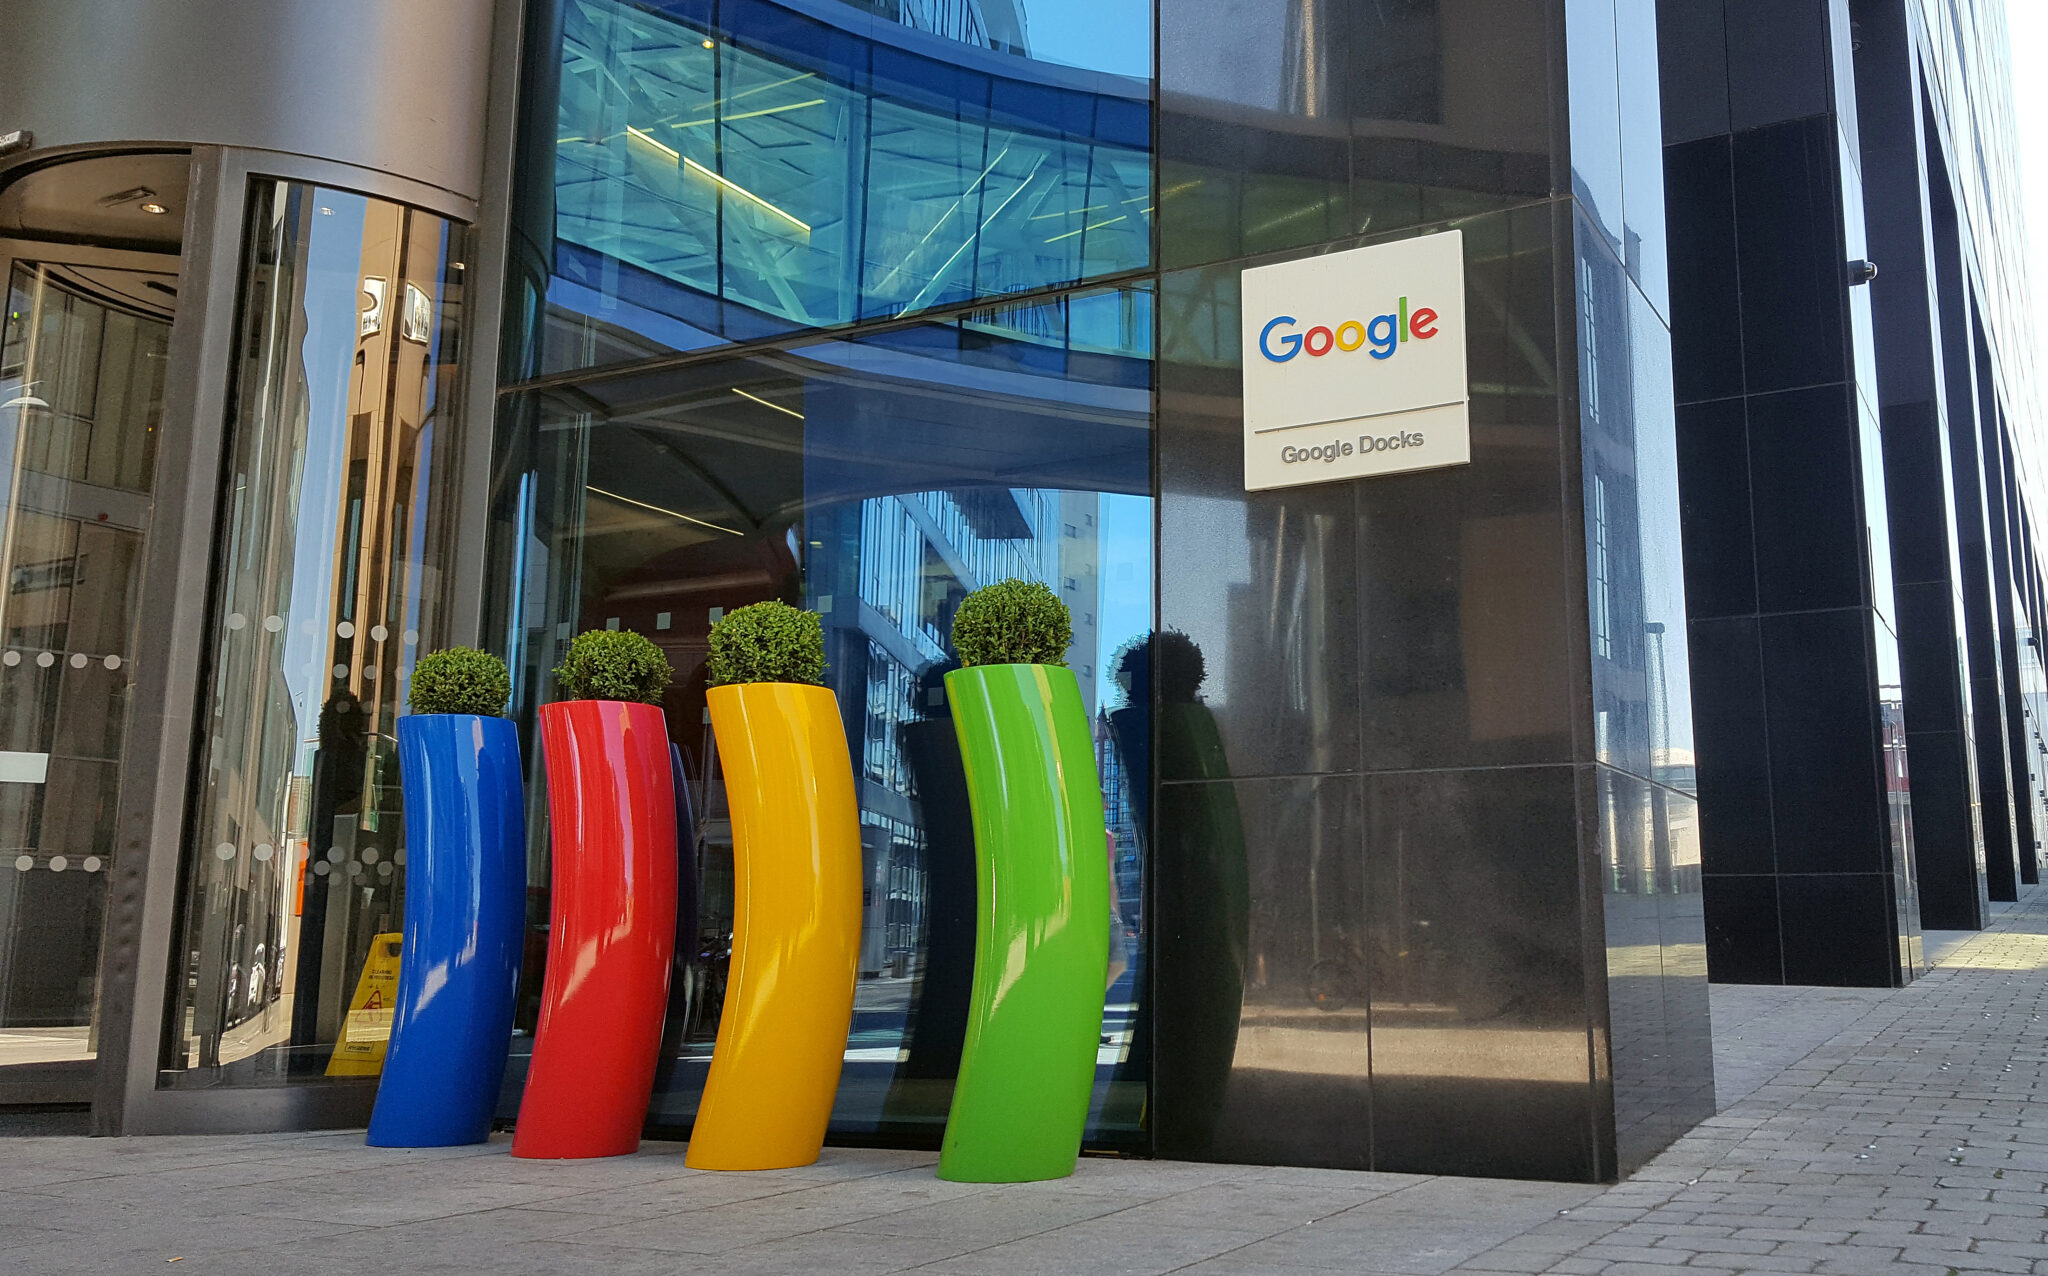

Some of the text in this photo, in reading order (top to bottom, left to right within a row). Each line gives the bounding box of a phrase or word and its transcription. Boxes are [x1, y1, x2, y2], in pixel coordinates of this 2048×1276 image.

[1259, 296, 1439, 363] Google
[1281, 430, 1424, 464] Google Docks
